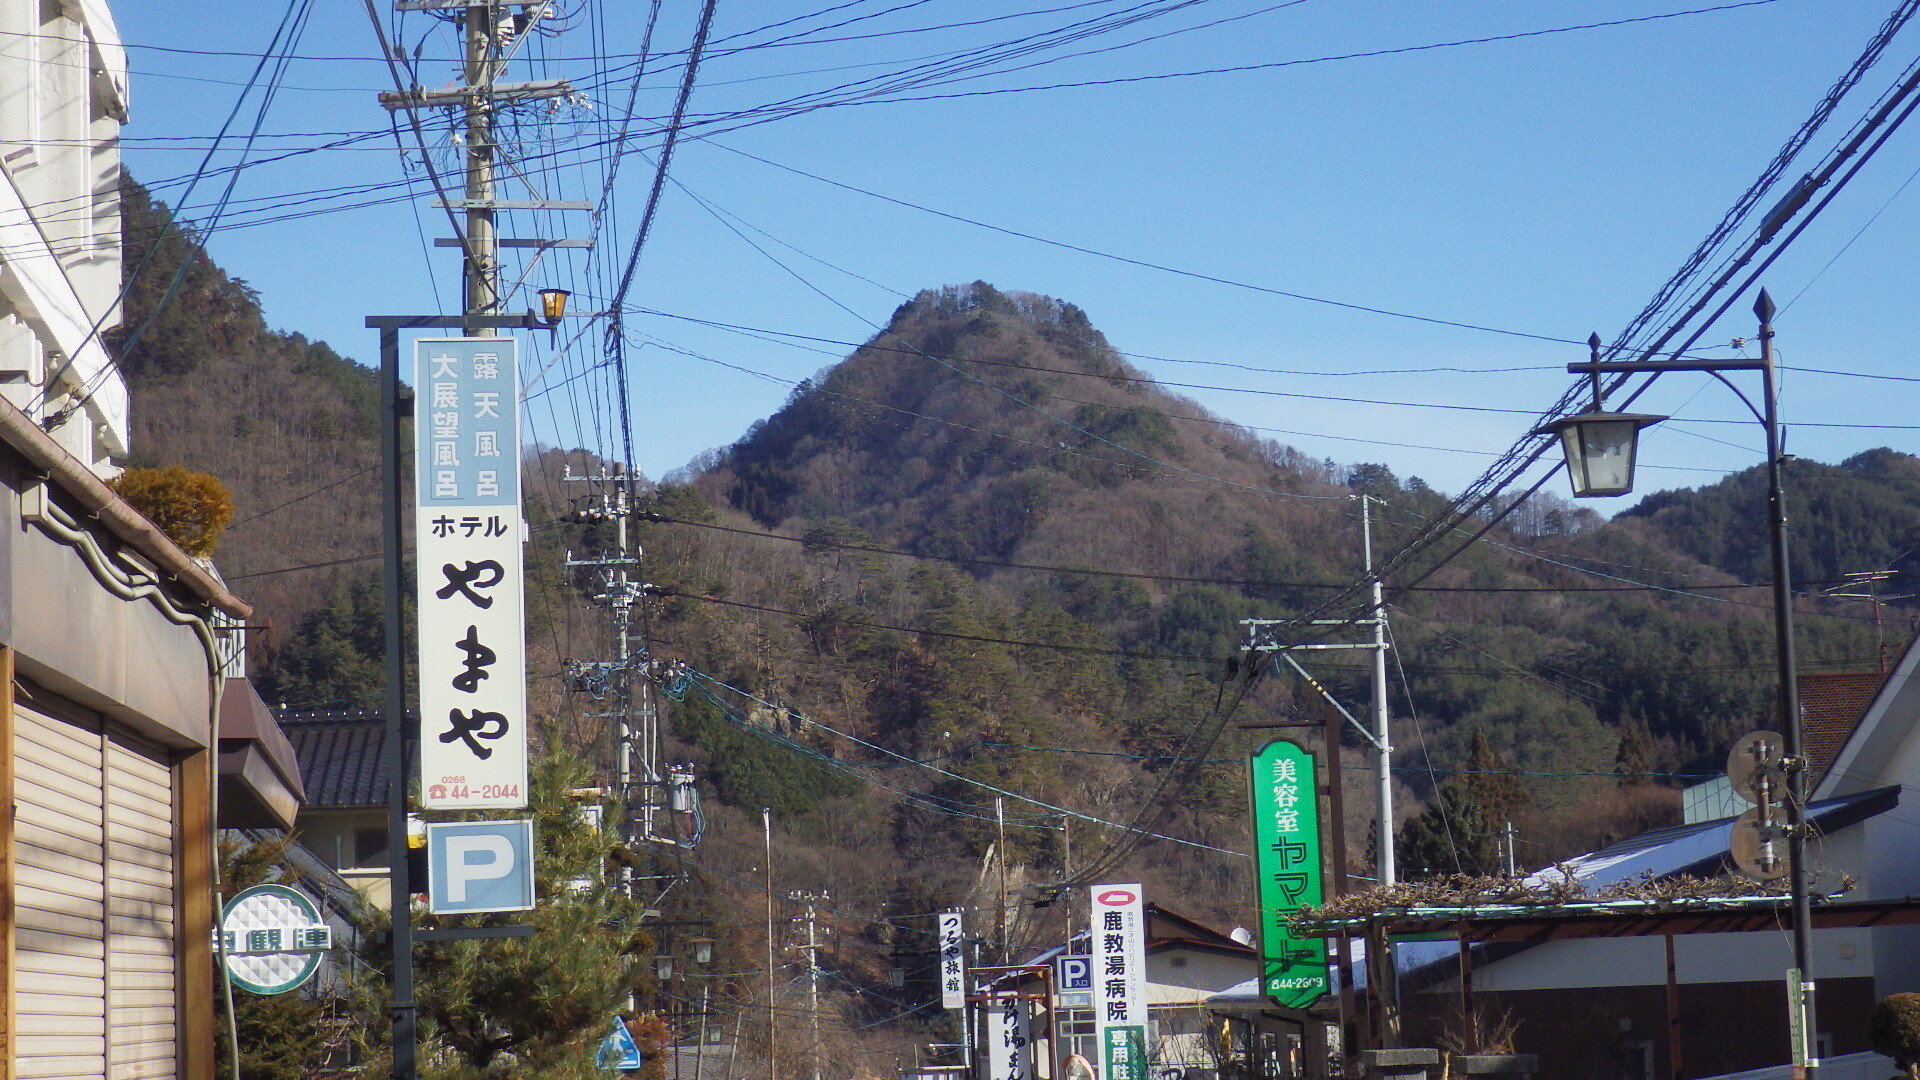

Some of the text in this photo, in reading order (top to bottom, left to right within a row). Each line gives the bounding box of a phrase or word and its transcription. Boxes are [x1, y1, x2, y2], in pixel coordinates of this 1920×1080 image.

[431, 352, 460, 498] 大展望風呂
[473, 352, 500, 497] 露天風呂
[431, 514, 508, 539] ホテル
[435, 559, 509, 760] やまや
[441, 776, 466, 784] 0268
[451, 784, 519, 799] 44-2044
[1271, 758, 1299, 833] 美容室
[445, 834, 515, 903] P
[1064, 960, 1087, 988] P
[1075, 979, 1088, 987] 入口
[1103, 911, 1128, 1021] 鹿教湯病院
